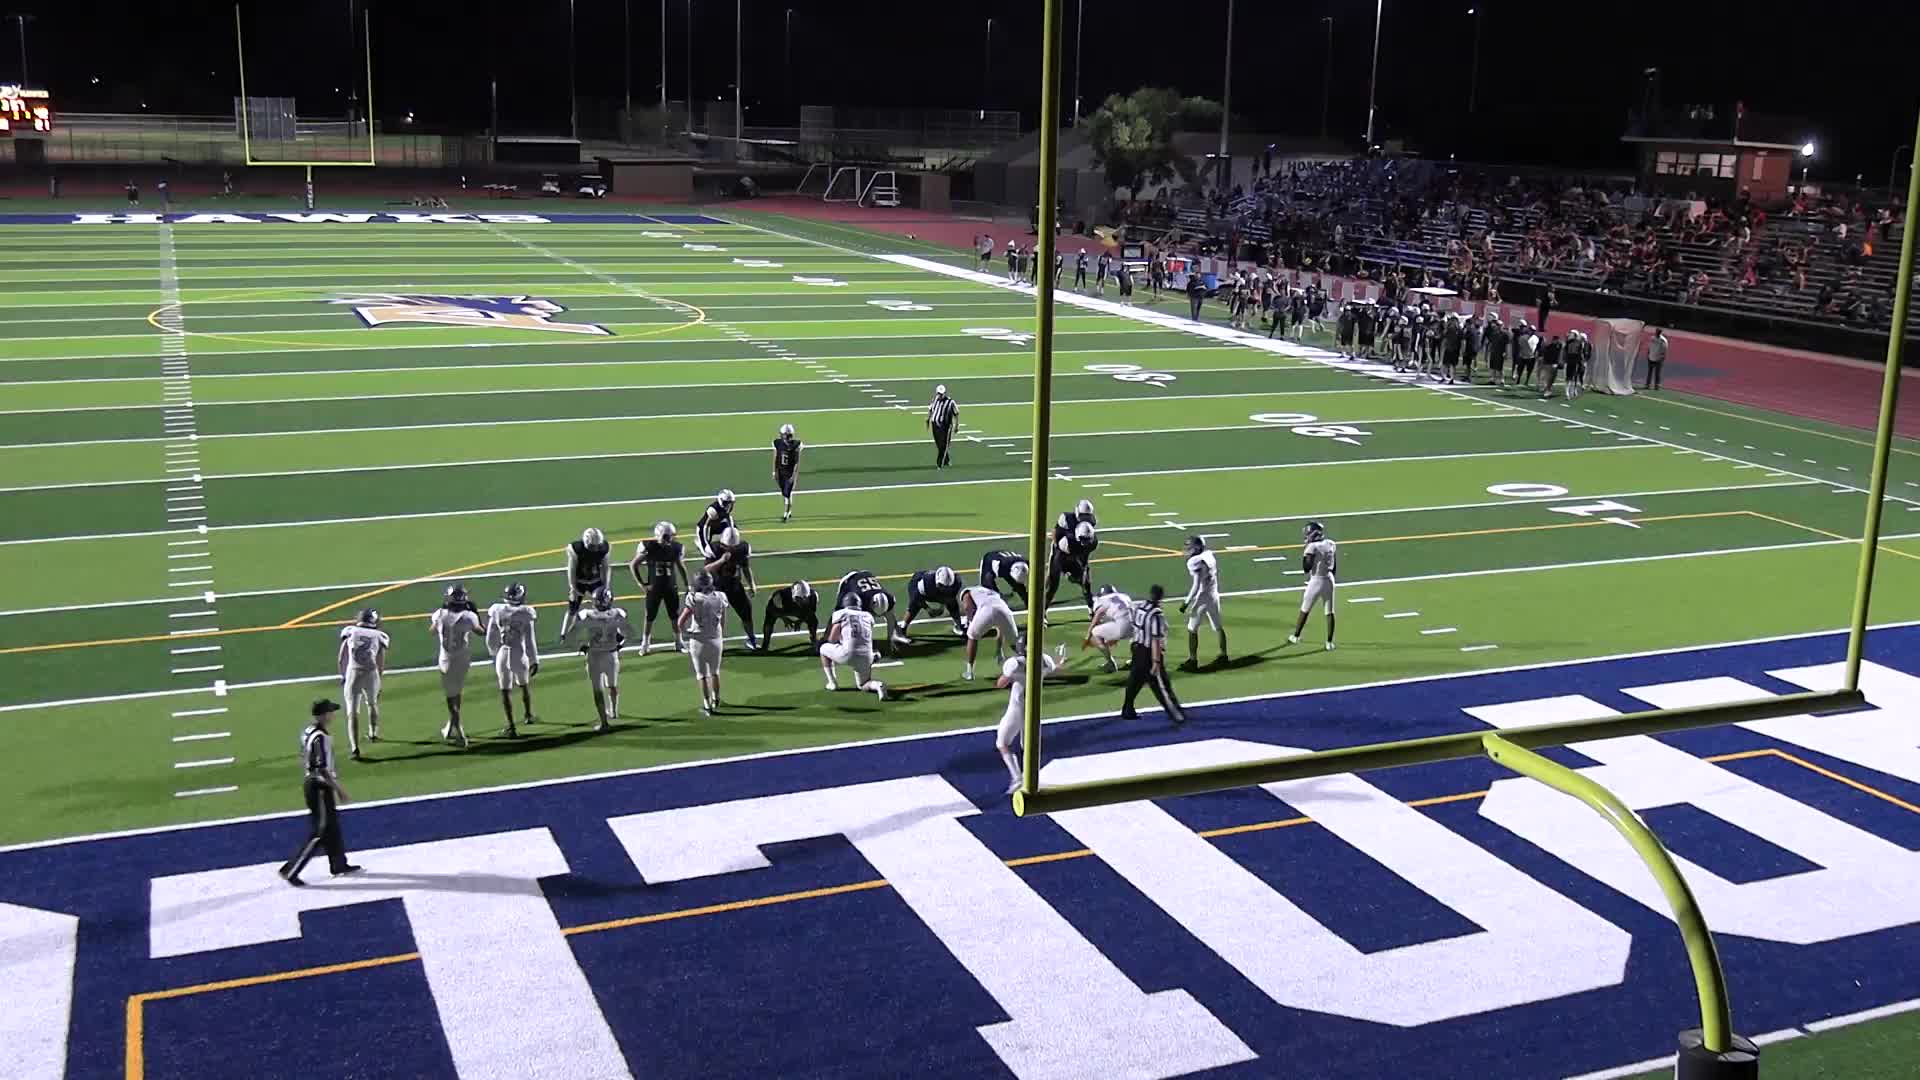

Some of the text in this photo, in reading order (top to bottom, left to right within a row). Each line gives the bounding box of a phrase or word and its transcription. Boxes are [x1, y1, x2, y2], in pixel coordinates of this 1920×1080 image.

[72, 213, 552, 224] HAWKS
[1083, 364, 1177, 383] 30
[1249, 412, 1373, 438] 20
[1486, 482, 1642, 518] 10
[857, 576, 882, 592] 55
